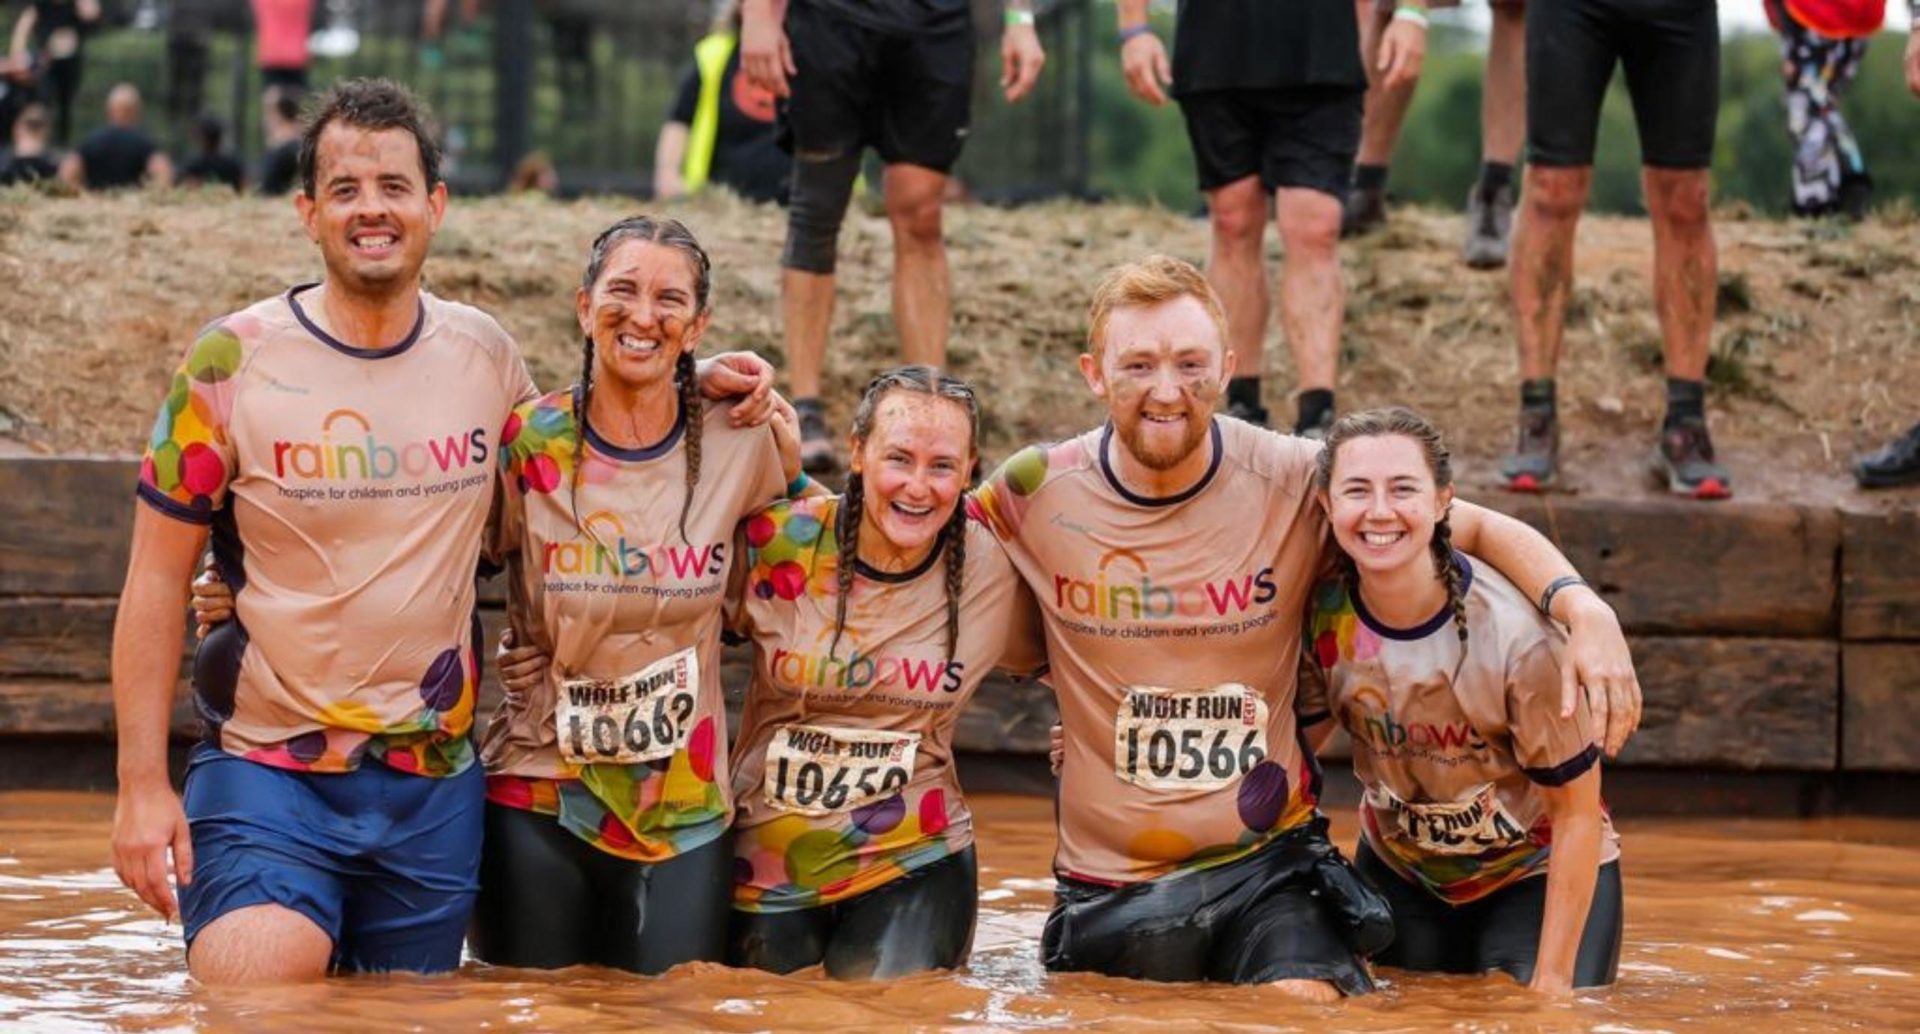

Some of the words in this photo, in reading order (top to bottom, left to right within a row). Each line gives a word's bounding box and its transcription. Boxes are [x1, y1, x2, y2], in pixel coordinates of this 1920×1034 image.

[274, 428, 488, 479] rainbows
[278, 486, 326, 500] hospice
[329, 486, 346, 500] for
[348, 486, 393, 500] children
[395, 484, 421, 497] and
[424, 480, 460, 496] young
[542, 537, 725, 580] rainbows
[584, 581, 599, 593] for
[1055, 567, 1278, 619] rainbows
[1100, 624, 1117, 637] for
[1120, 624, 1169, 638] children
[1172, 624, 1198, 637] and
[1200, 620, 1240, 637] young
[568, 684, 631, 706] WOLF
[634, 668, 676, 698] RUN
[772, 648, 965, 692] rainbows
[1131, 694, 1192, 719] WOLF
[1196, 696, 1242, 719] RUN
[1127, 728, 1265, 780] 10566
